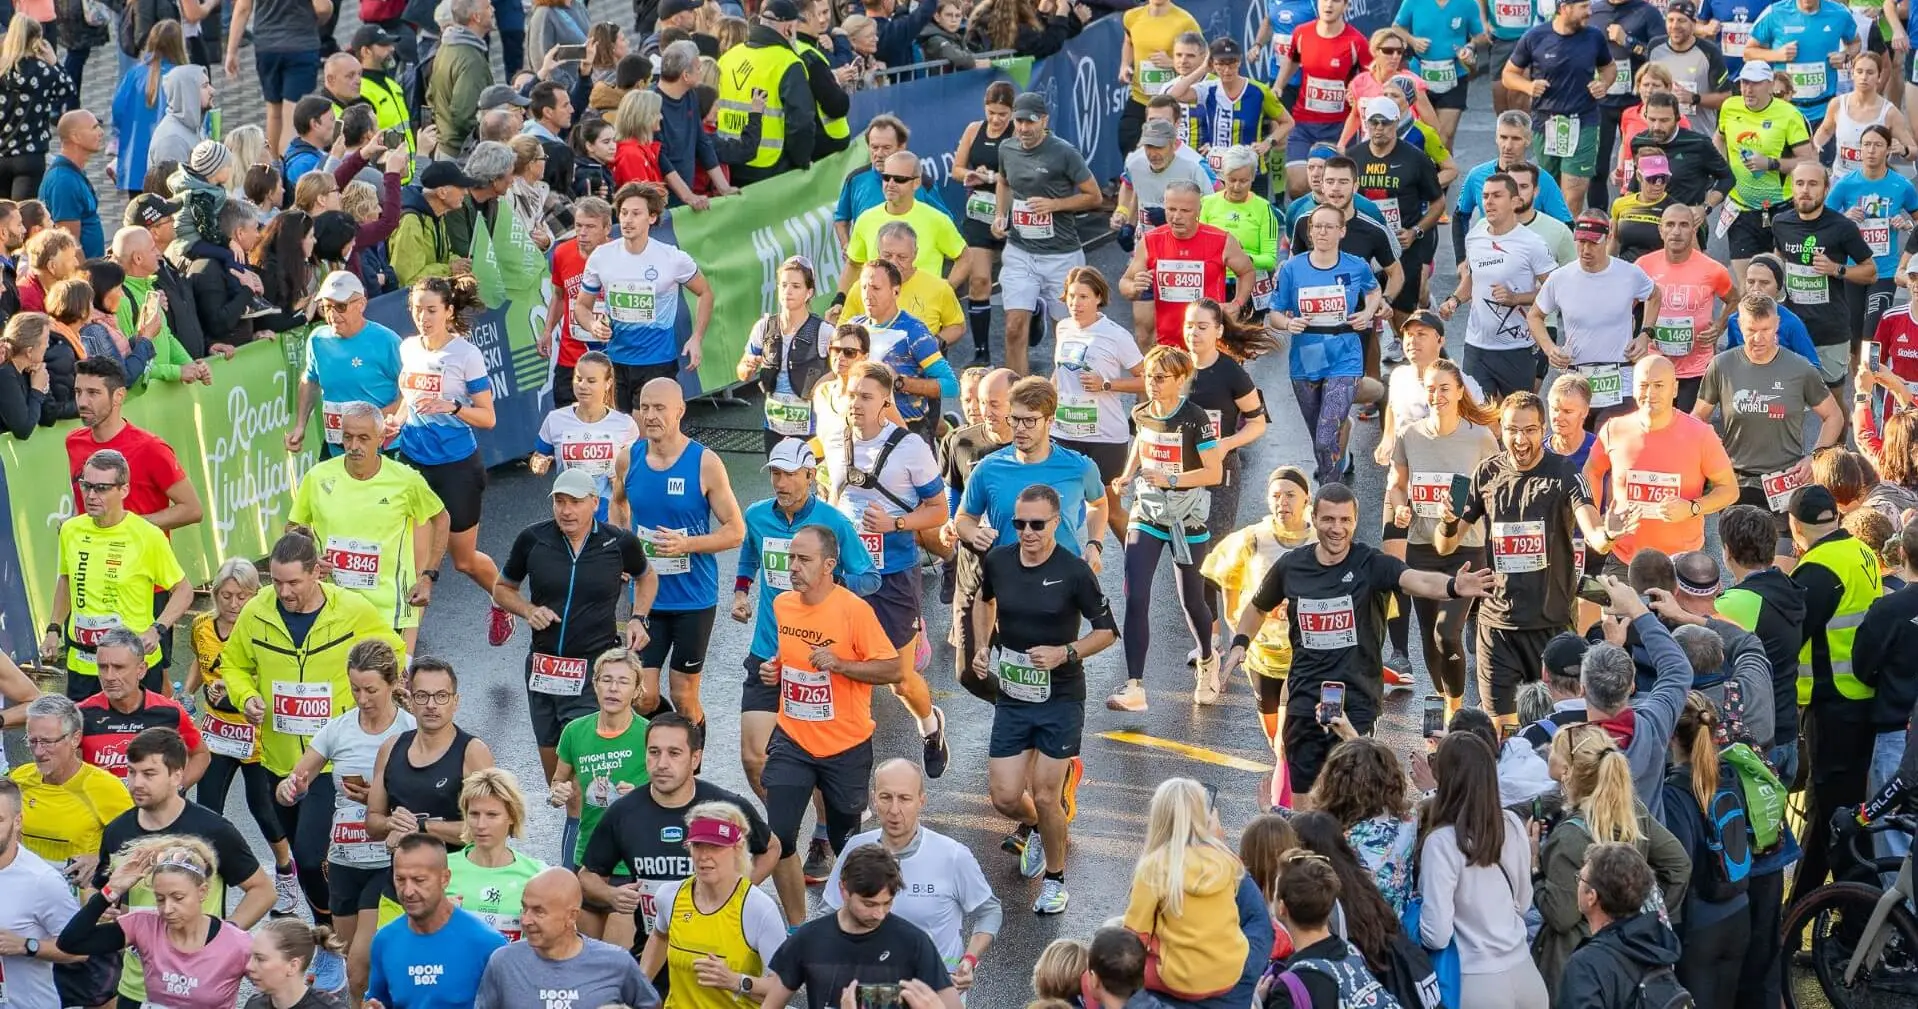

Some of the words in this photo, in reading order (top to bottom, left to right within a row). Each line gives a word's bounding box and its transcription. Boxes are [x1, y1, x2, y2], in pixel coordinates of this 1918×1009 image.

[1439, 70, 1453, 81] 213
[1616, 71, 1628, 82] 57
[1804, 73, 1823, 84] 1535
[1322, 89, 1343, 101] 7518
[1366, 163, 1386, 175] MKD
[1358, 176, 1399, 189] UNNER
[984, 204, 996, 215] 12
[1863, 230, 1887, 243] 8196
[1163, 273, 1169, 286] C
[1175, 273, 1201, 287] 8490
[615, 292, 620, 304] C
[627, 293, 653, 308] 1364
[1318, 297, 1344, 311] 3802
[470, 322, 496, 345] AGEN
[1667, 328, 1691, 341] 1469
[415, 374, 439, 391] 6053
[1593, 376, 1618, 391] 2027
[228, 371, 289, 450] Road
[1740, 403, 1769, 413] WORLD
[570, 445, 577, 459] C
[583, 444, 610, 458] 6057
[670, 481, 683, 491] IM
[1512, 537, 1542, 553] 7929
[332, 553, 339, 567] C
[346, 555, 376, 570] 3846
[76, 551, 89, 608] Gmünd
[1307, 617, 1314, 629] E
[1320, 613, 1350, 629] 7787
[541, 657, 547, 670] C
[552, 659, 582, 676] 7444
[1005, 666, 1011, 679] C
[1016, 669, 1046, 684] 1402
[786, 685, 794, 699] E
[799, 687, 829, 702] 7262
[280, 700, 288, 714] C
[295, 700, 328, 716] 7008
[220, 725, 251, 740] 6204
[579, 753, 605, 764] DVIGNI
[608, 750, 632, 760] ROKO
[580, 765, 589, 774] ZA
[591, 759, 623, 772] LAŠKO!
[341, 827, 368, 842] Pung
[408, 964, 444, 976] BOOM
[162, 971, 198, 988] BOOM
[414, 975, 437, 986] BOX
[167, 982, 190, 996] BOX
[540, 990, 579, 1000] BOOM
[546, 1000, 571, 1009] BOX
